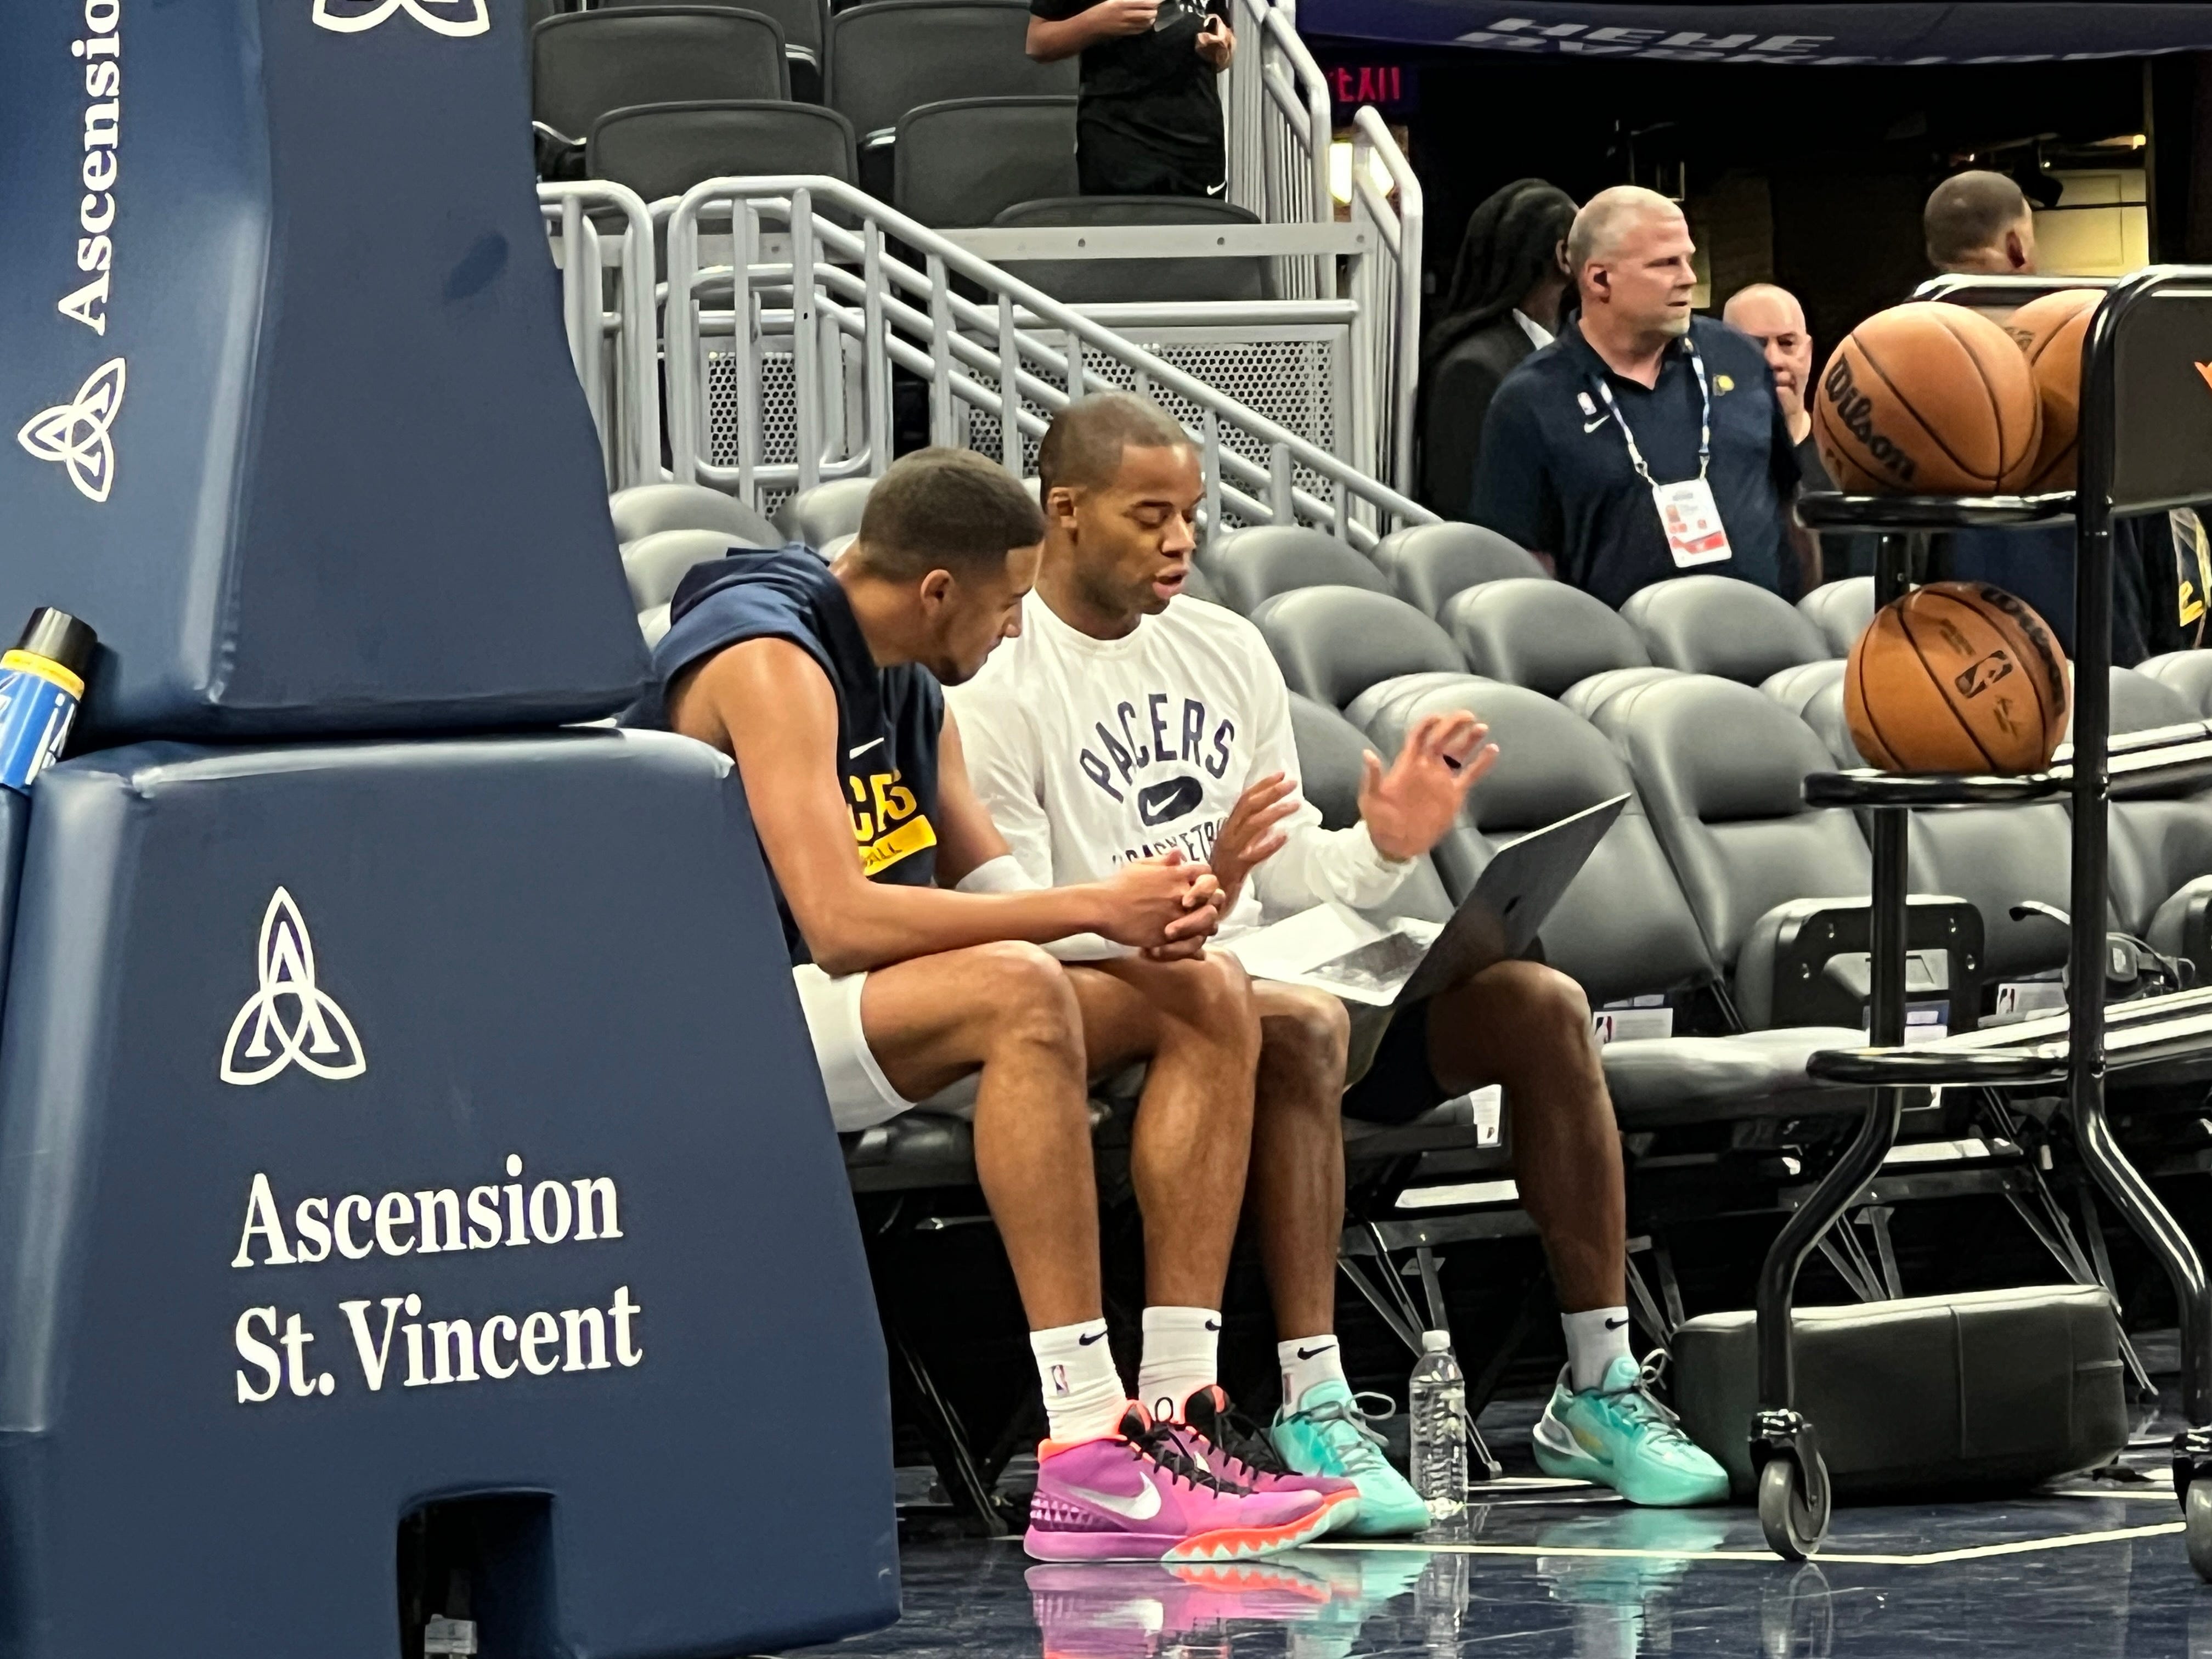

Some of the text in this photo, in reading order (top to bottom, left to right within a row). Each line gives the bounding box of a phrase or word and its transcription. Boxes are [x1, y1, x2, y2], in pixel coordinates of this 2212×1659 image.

[1825, 352, 1918, 482] Wilson
[1079, 693, 1235, 804] PACERS
[230, 1154, 624, 1268] Ascension
[235, 1285, 643, 1403] St. Vincent
